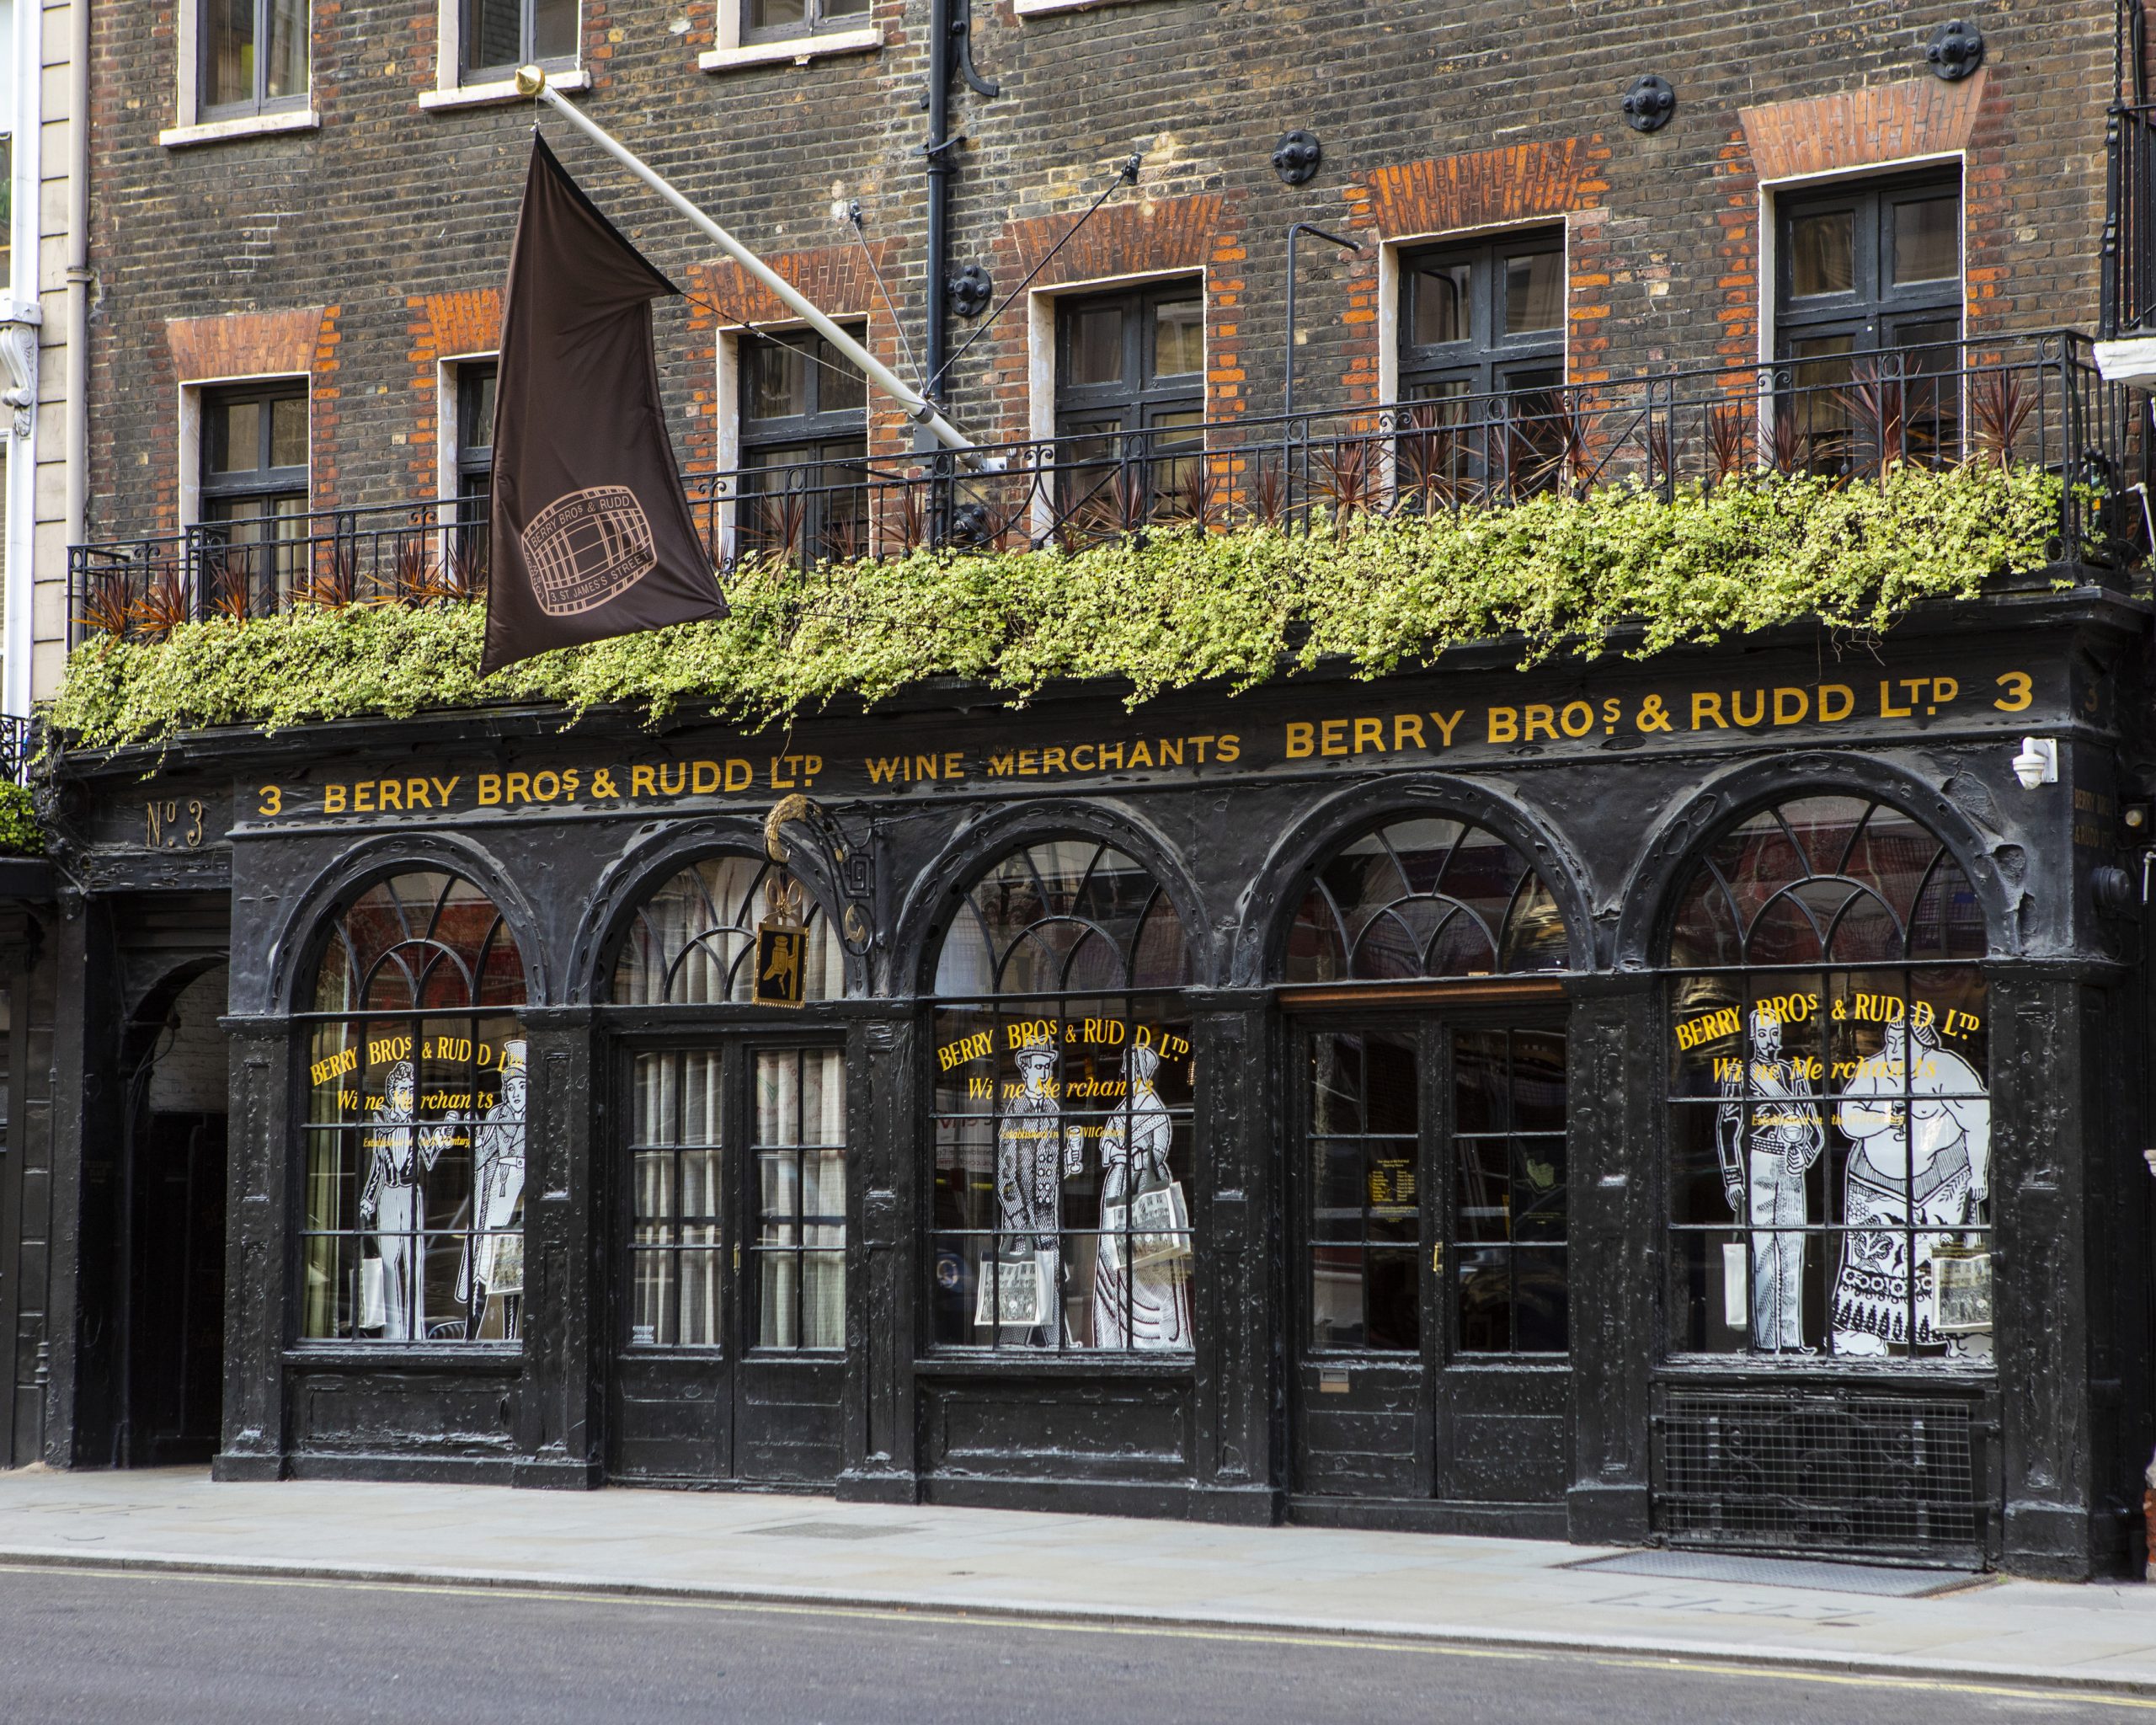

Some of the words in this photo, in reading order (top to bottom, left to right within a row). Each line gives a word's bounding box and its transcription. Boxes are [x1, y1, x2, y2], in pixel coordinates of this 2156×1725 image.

[531, 517, 557, 548] BERRY
[587, 501, 596, 513] &
[600, 495, 630, 510] RUDD
[573, 575, 608, 599] JAMES'S
[611, 549, 649, 580] STREET
[1994, 671, 2033, 712] 3
[2084, 687, 2099, 713] 3
[259, 785, 282, 815] 3
[324, 776, 460, 814] BERRY
[591, 767, 620, 798] &
[631, 759, 754, 797] RUDD
[865, 751, 965, 783] WINE
[987, 734, 1241, 777] MERCHANTS
[1286, 709, 1465, 759] BERRY
[1636, 693, 1673, 733] &
[1691, 684, 1855, 731] RUDD
[188, 799, 202, 846] 3
[937, 1029, 994, 1072] BERRY
[1065, 1023, 1076, 1043] &
[1083, 1017, 1151, 1051] RUDD
[1675, 1005, 1742, 1051] BERRY
[1832, 999, 1847, 1021] &
[1854, 992, 1935, 1028] RUDD
[310, 1046, 358, 1087] BERRY
[422, 1041, 432, 1059] &
[437, 1036, 492, 1066] RUDD
[338, 1089, 386, 1111] Wine
[969, 1077, 1027, 1101] Wine
